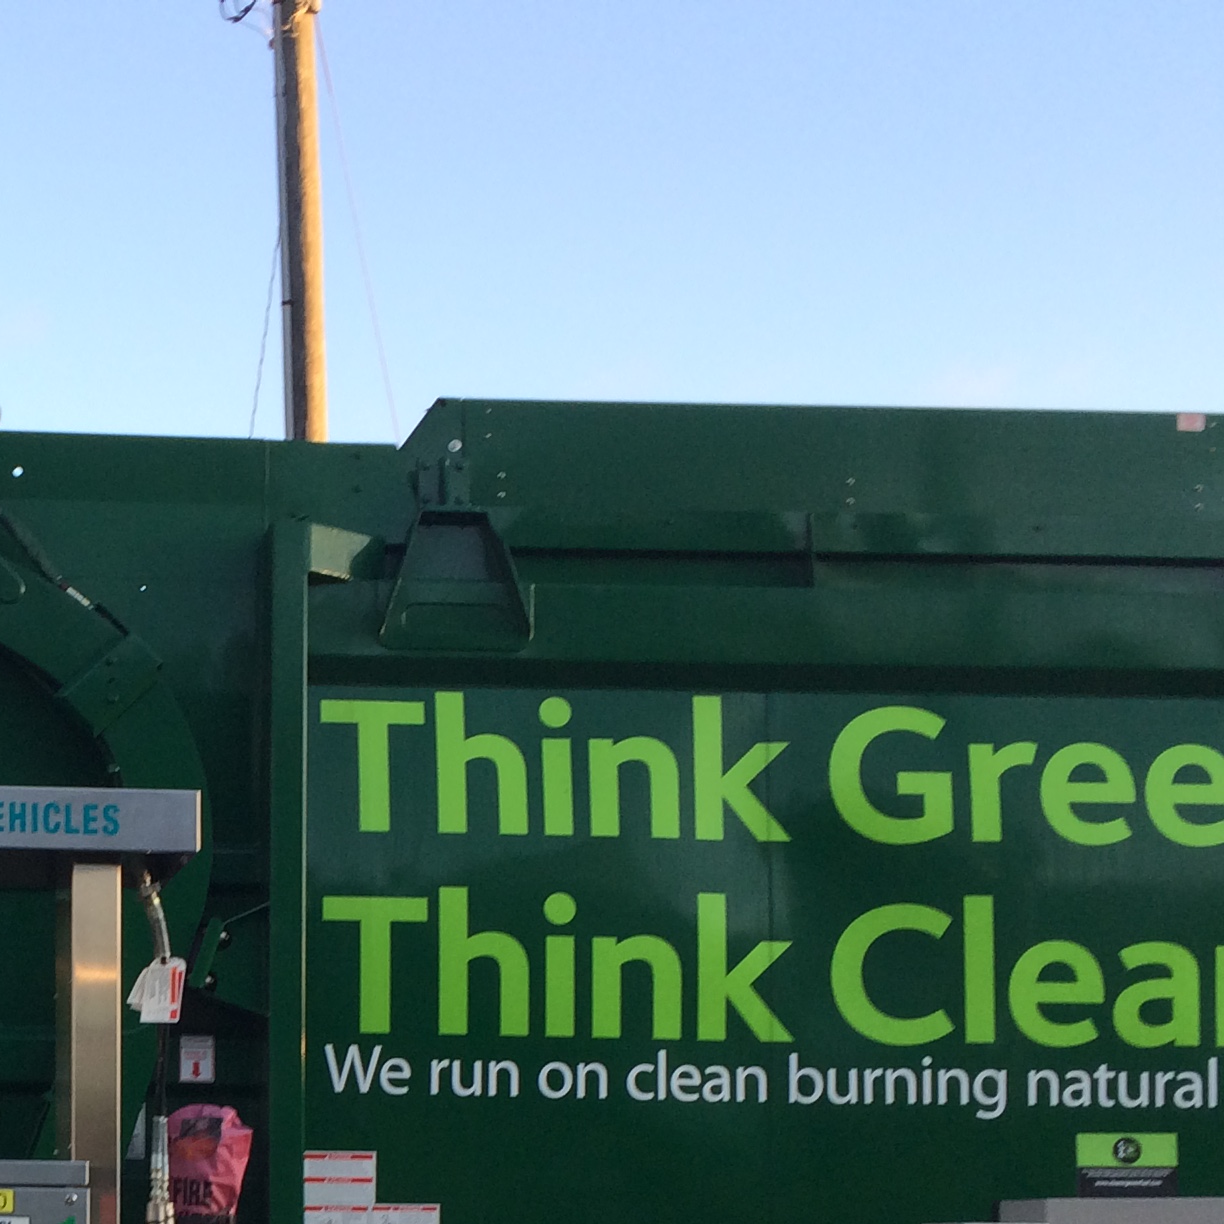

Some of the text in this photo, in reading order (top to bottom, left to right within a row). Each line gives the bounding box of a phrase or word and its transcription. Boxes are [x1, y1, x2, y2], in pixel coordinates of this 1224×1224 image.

[319, 691, 792, 843] Think
[322, 886, 1224, 1047] Think Clea
[324, 1043, 1218, 1120] We run on clean burning natural
